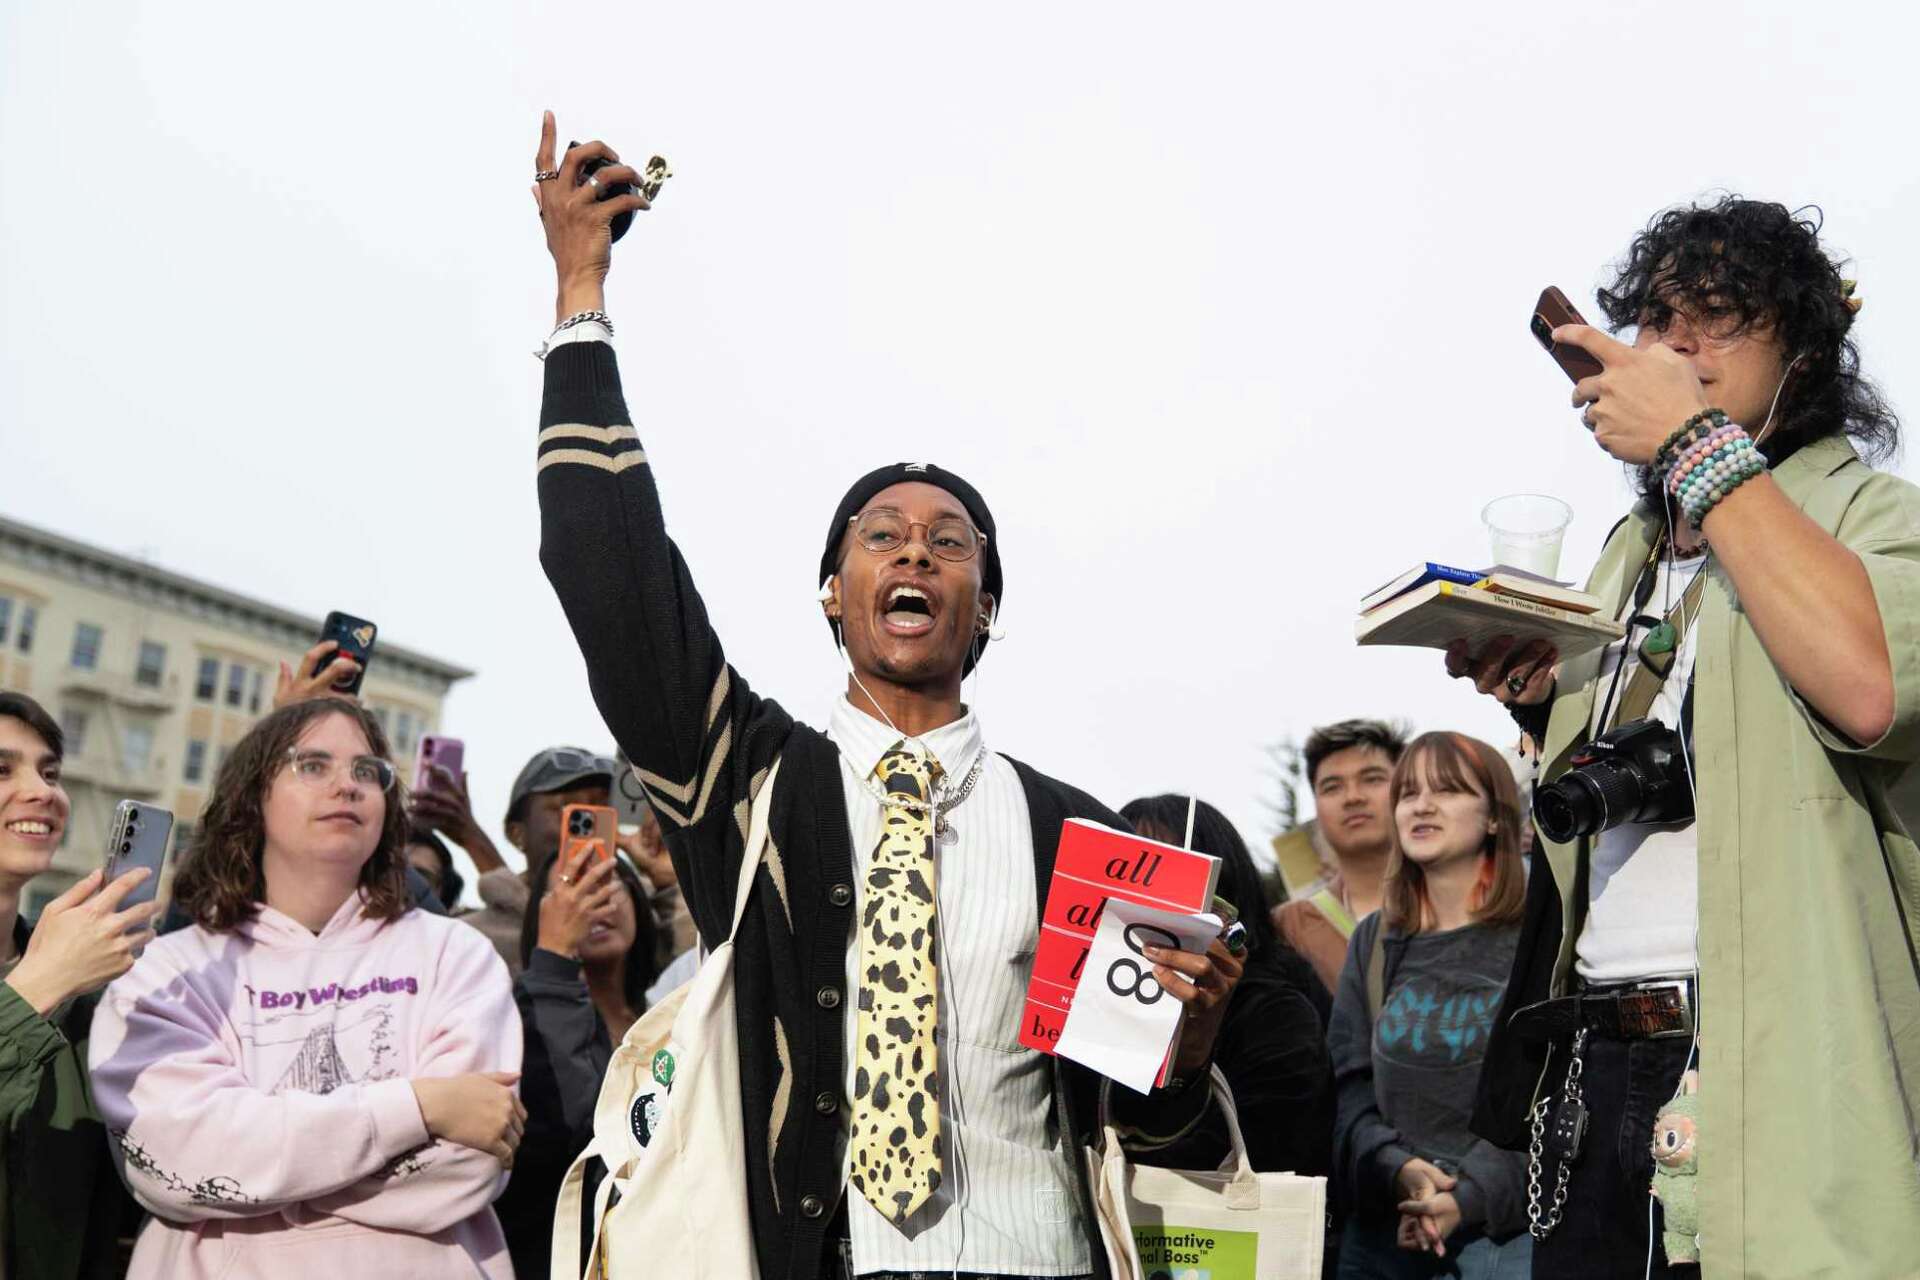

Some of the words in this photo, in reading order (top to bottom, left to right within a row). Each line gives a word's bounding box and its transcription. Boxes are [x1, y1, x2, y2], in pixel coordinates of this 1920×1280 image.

[1597, 741, 1614, 749] Nikon
[1105, 851, 1162, 887] all
[260, 990, 306, 1009] Boy
[308, 976, 418, 1006] Wrestling
[1032, 1015, 1060, 1042] be
[1135, 1232, 1215, 1249] formative
[1141, 1247, 1158, 1264] nal
